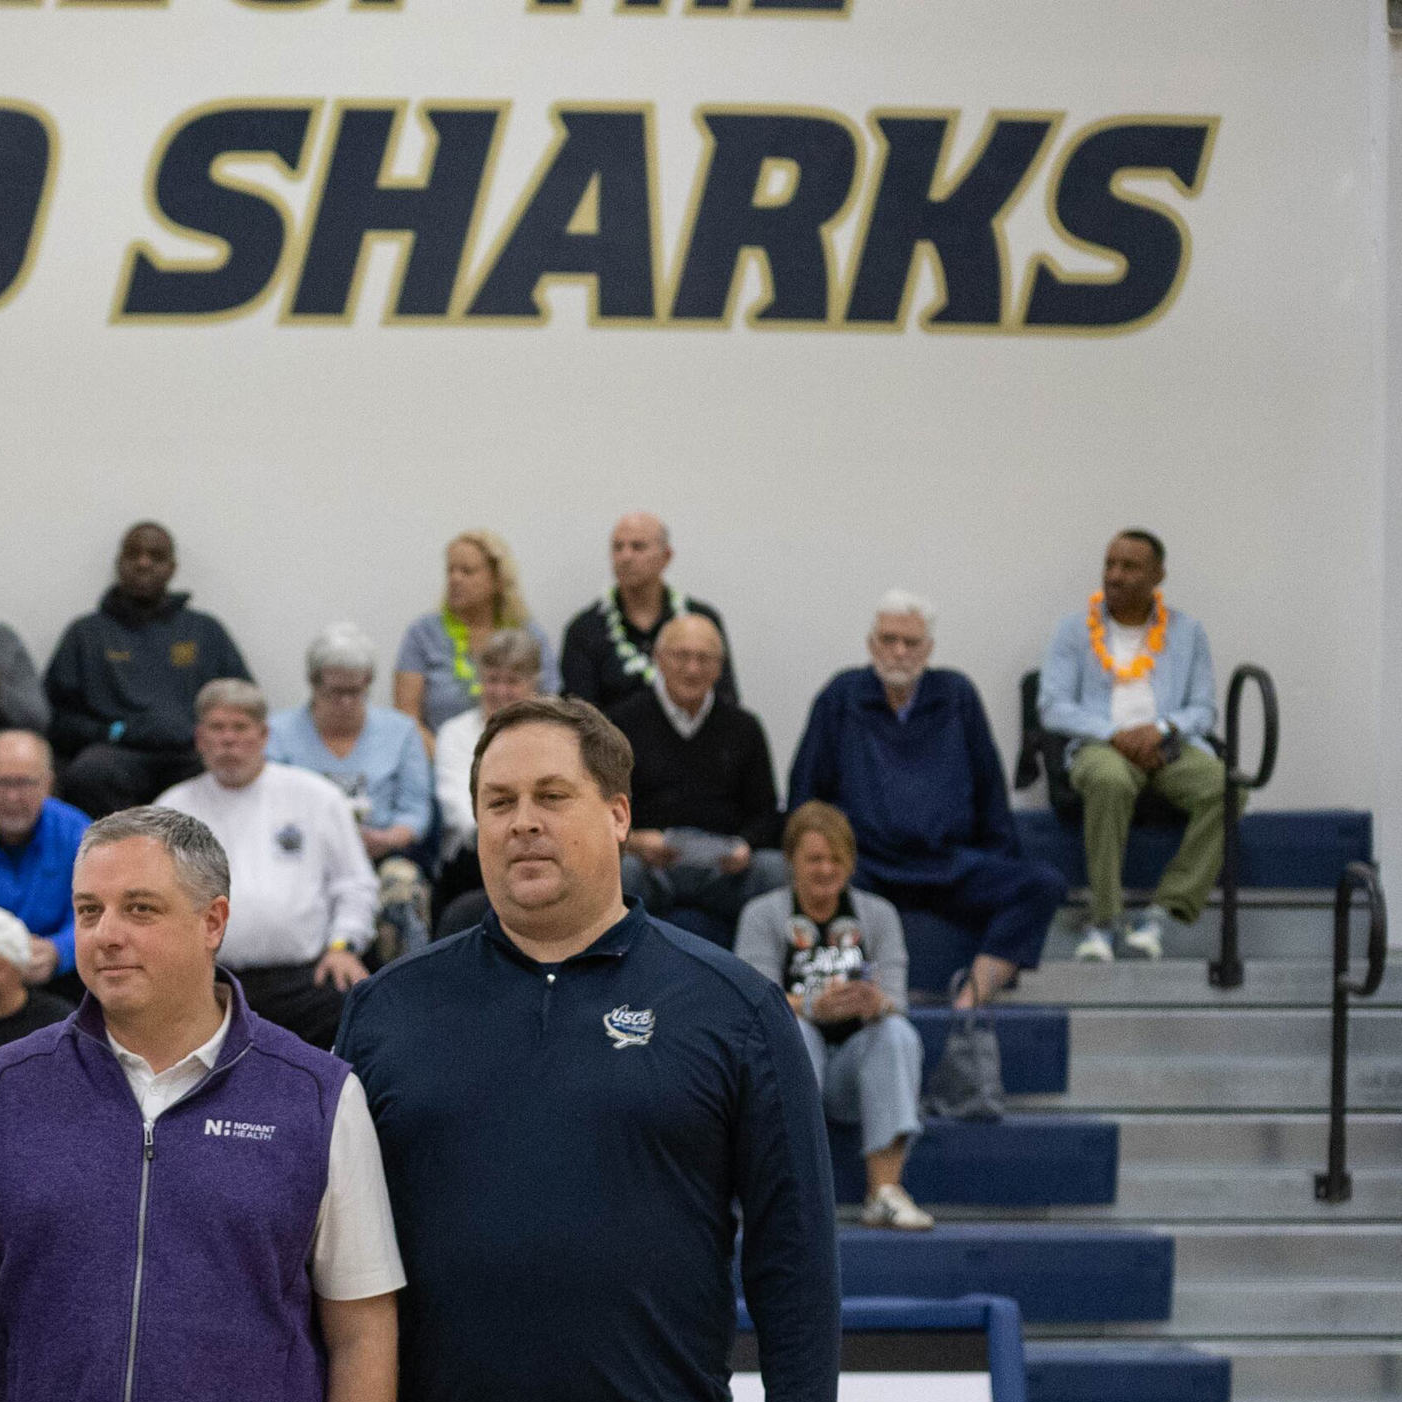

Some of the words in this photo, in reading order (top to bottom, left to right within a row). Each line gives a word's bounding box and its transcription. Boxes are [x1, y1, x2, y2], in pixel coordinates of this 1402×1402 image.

[107, 97, 1223, 338] SHARKS
[233, 1122, 277, 1133] NOVANT
[232, 1130, 273, 1141] HEALTH
